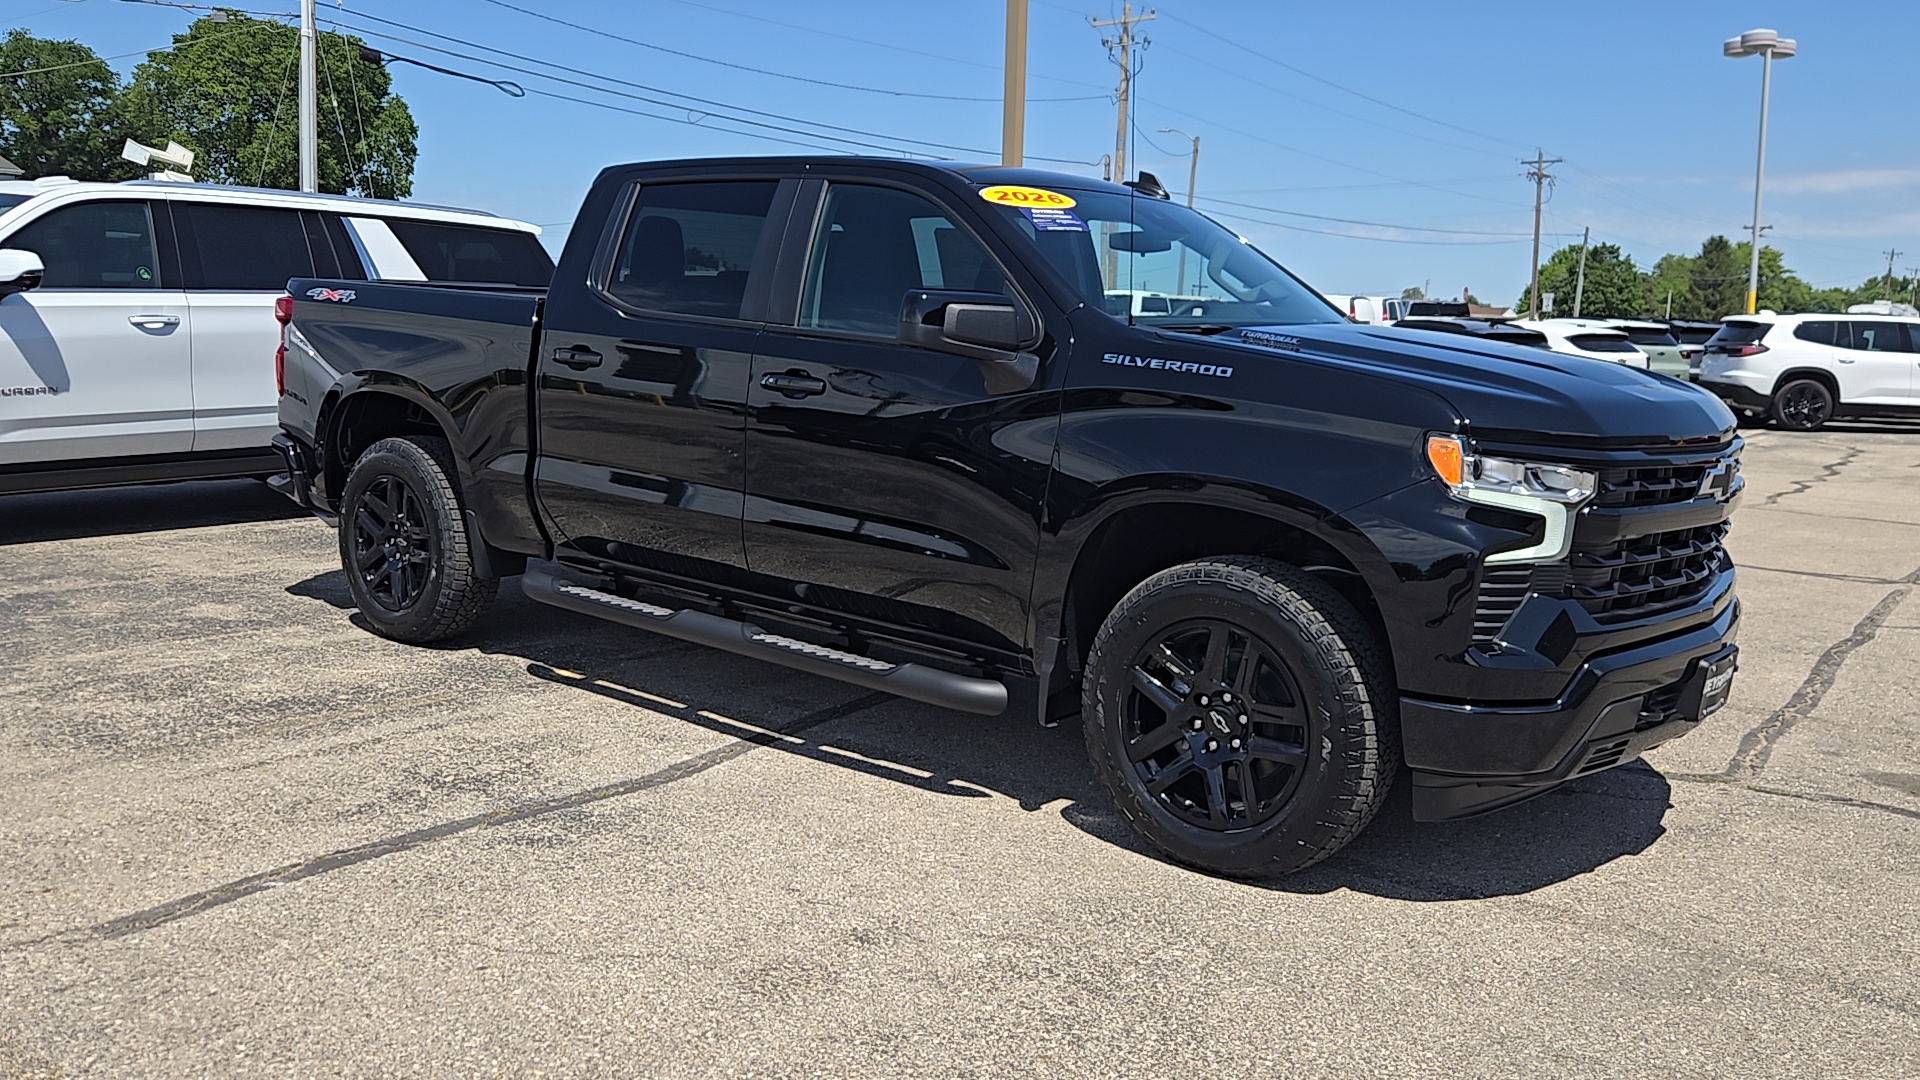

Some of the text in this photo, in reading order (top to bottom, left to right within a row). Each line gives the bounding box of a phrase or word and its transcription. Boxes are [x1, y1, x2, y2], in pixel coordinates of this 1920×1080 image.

[993, 190, 1065, 205] 2026
[1101, 352, 1234, 379] SILVERADO
[0, 386, 58, 397] URBAN
